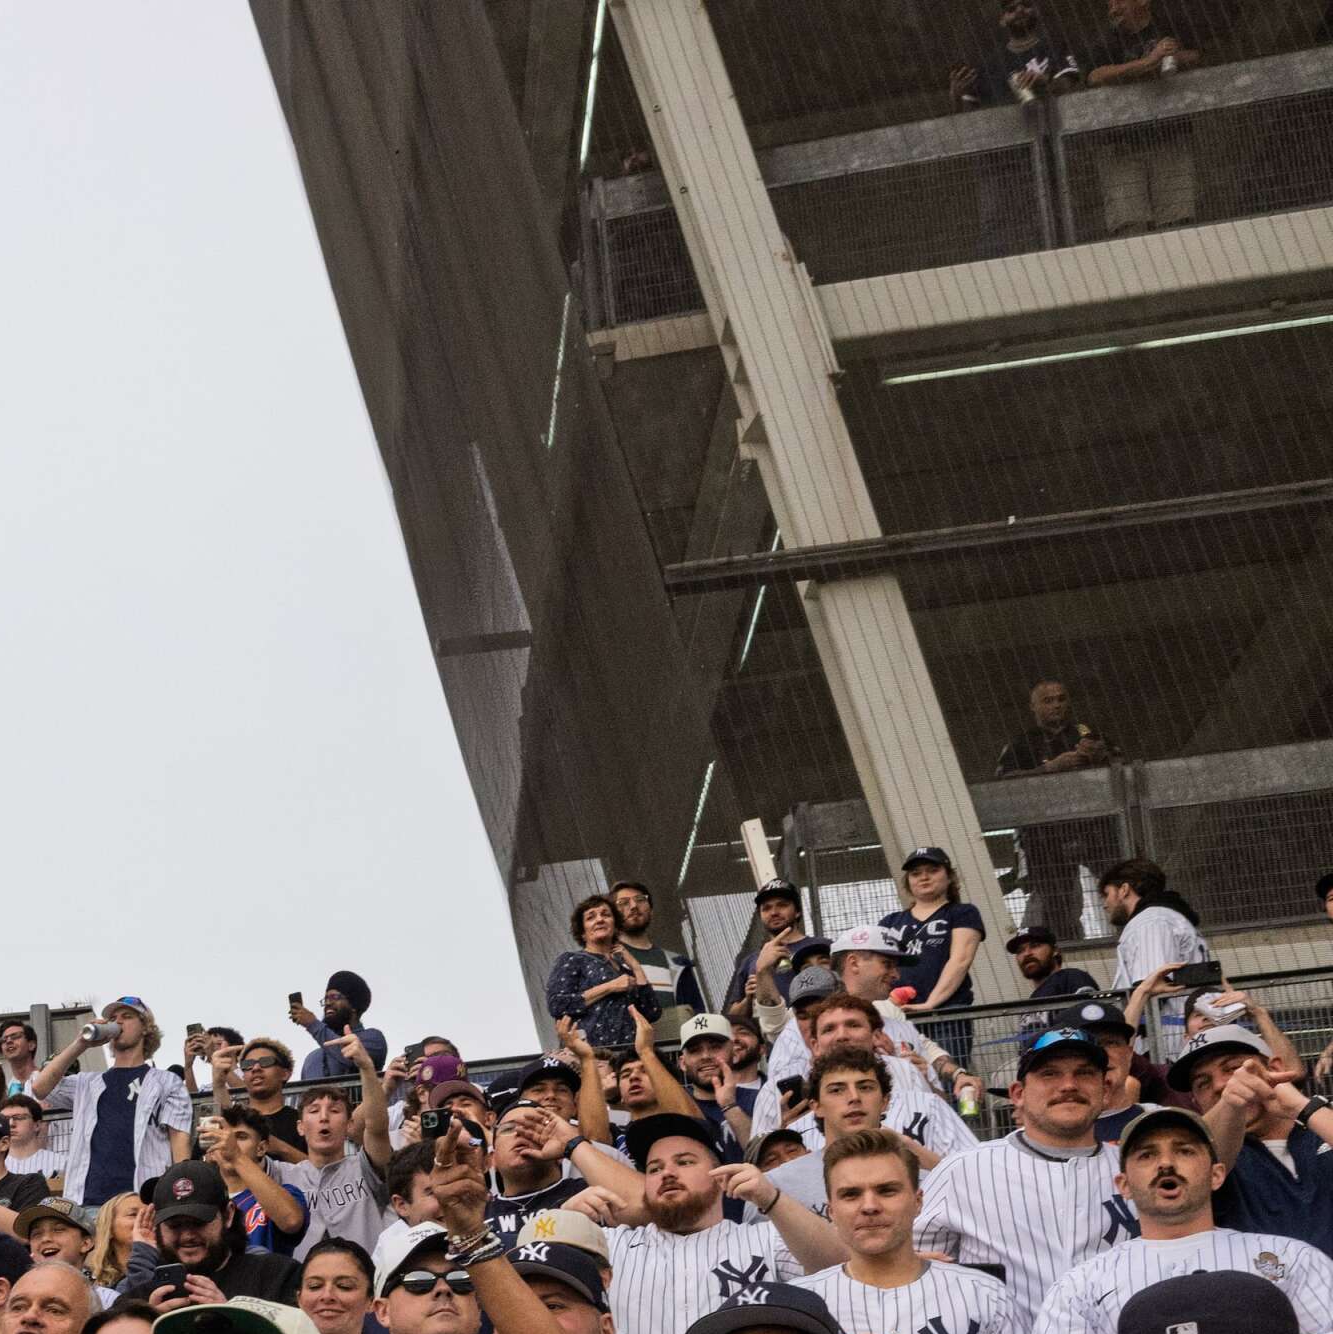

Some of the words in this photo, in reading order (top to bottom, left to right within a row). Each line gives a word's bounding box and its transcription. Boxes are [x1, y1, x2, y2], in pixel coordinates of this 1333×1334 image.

[321, 1177, 370, 1208] YORK
[519, 1241, 550, 1263] NY
[736, 1285, 770, 1306] NY
